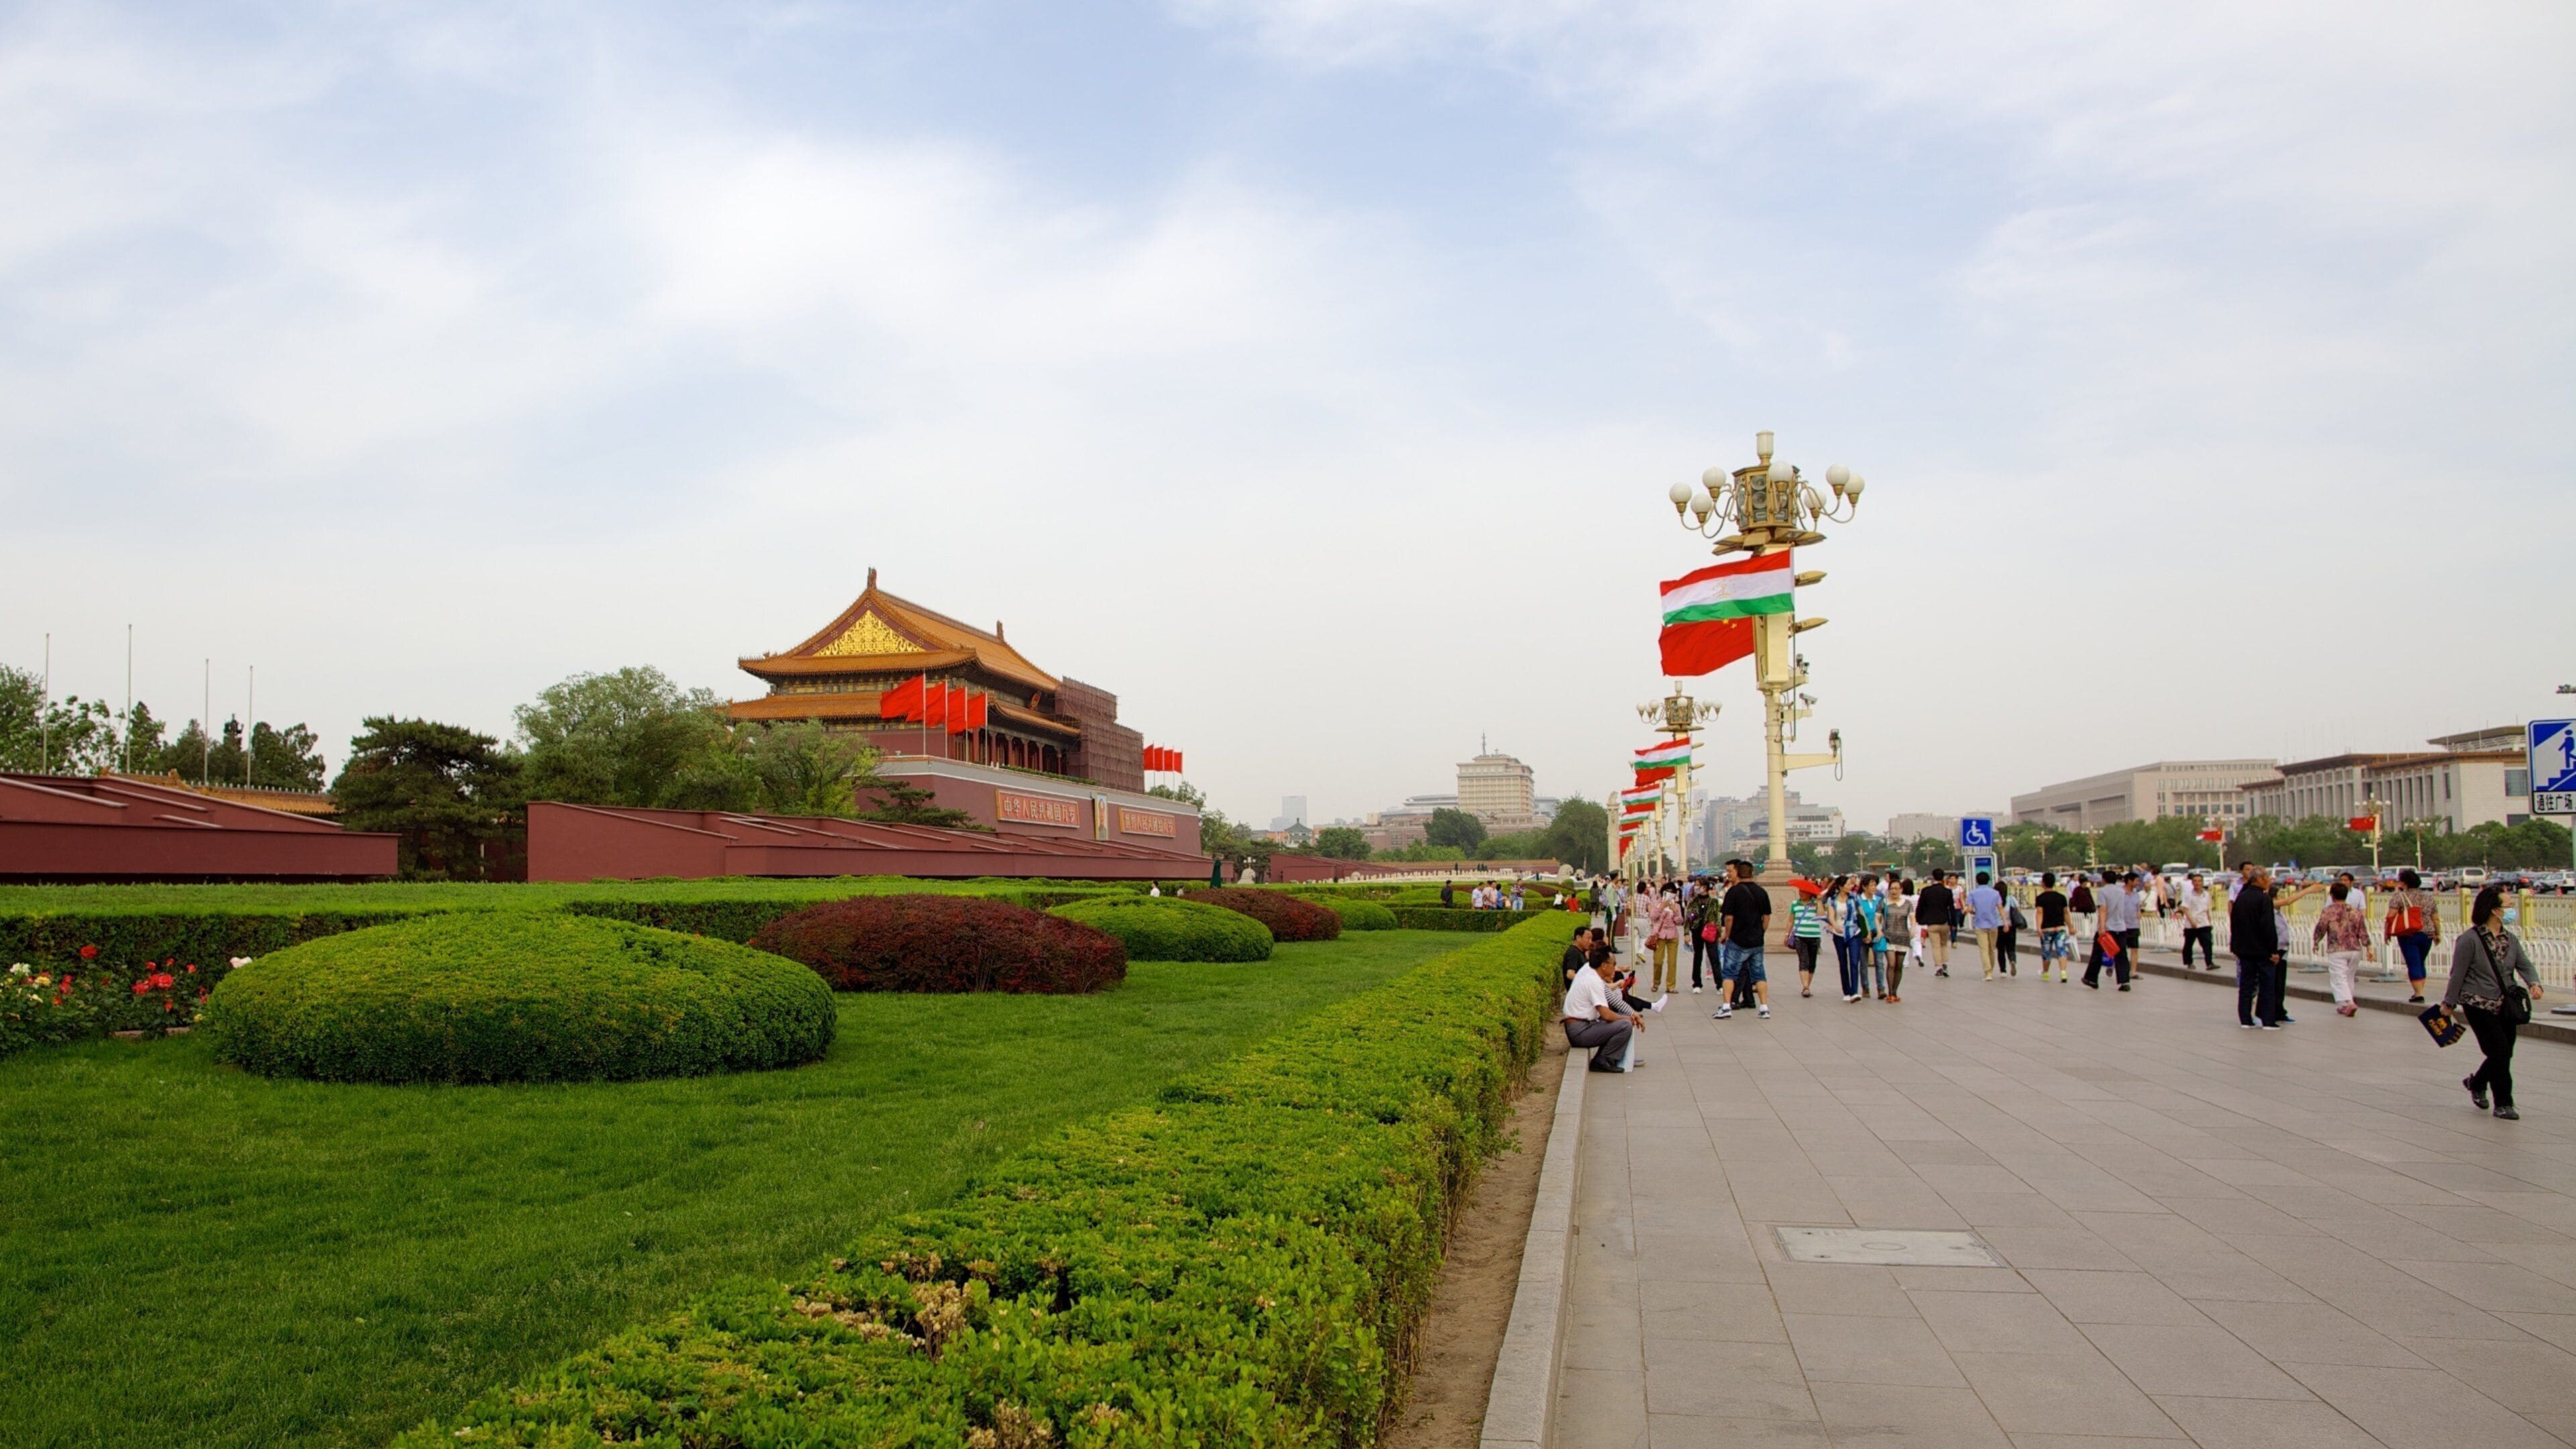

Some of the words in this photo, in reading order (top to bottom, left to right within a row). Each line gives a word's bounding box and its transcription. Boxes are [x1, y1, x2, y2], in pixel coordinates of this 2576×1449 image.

[1004, 796, 1075, 822] 中华人民共和国万岁
[2537, 794, 2573, 810] 通往广场
